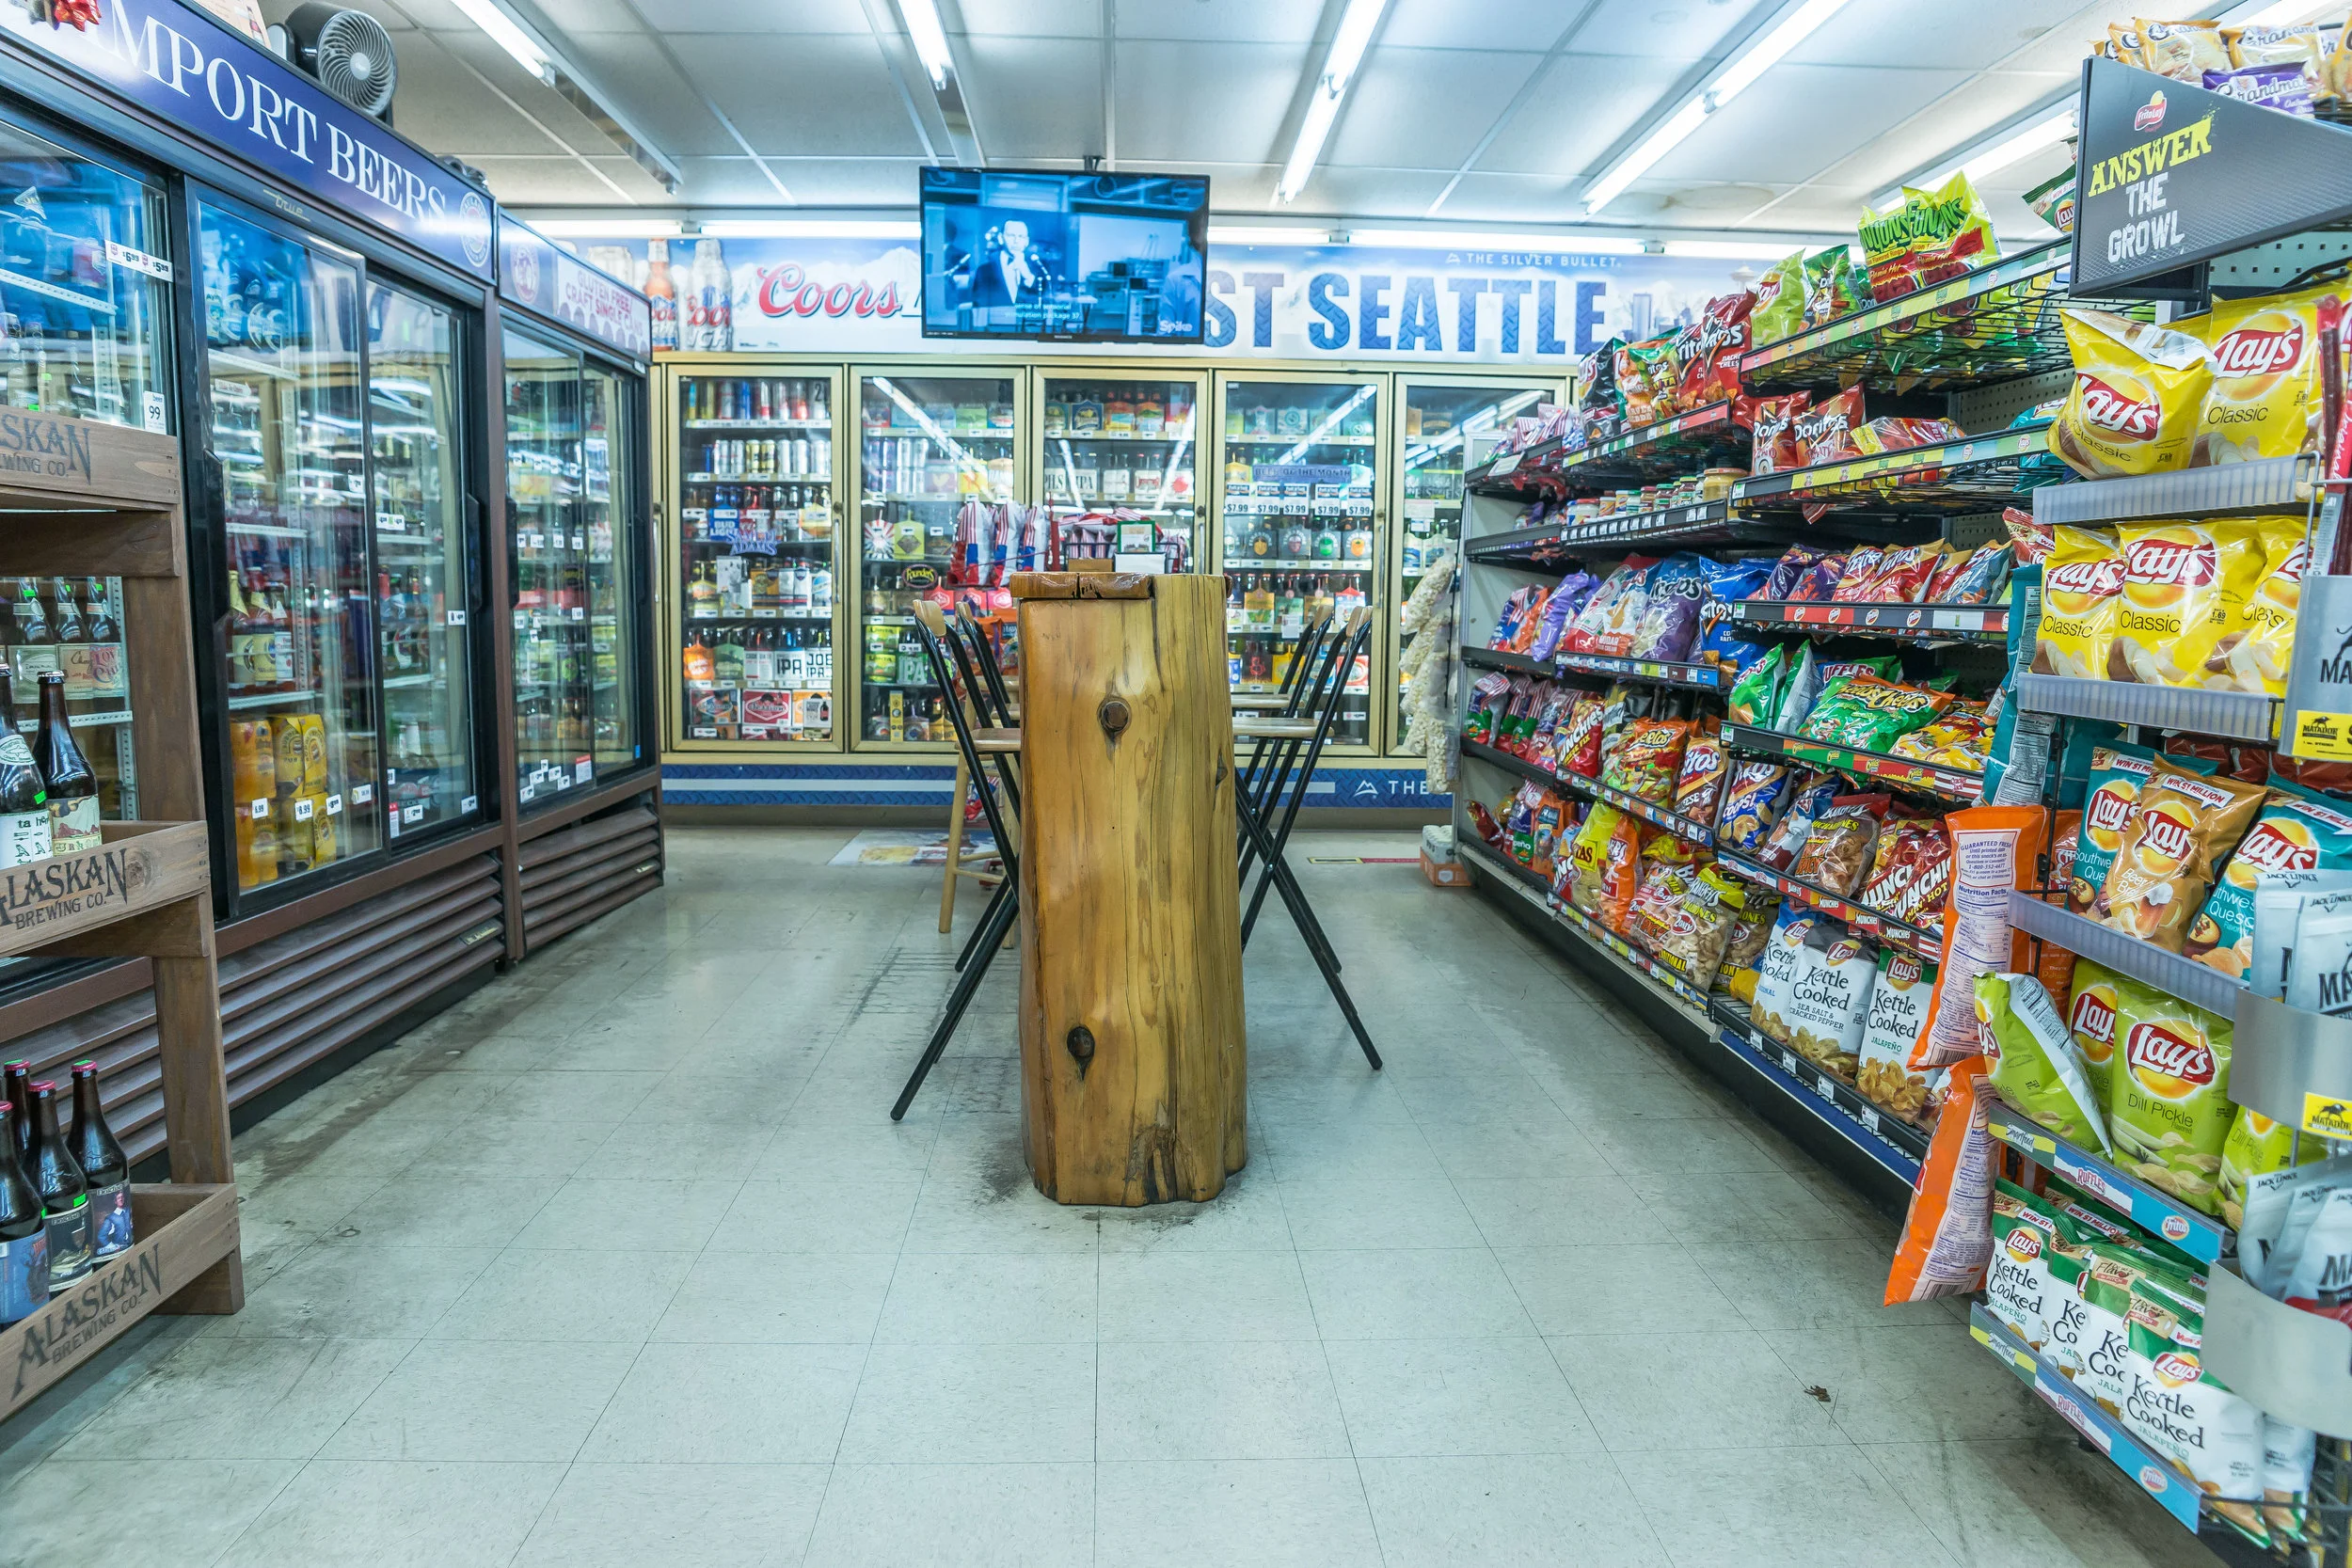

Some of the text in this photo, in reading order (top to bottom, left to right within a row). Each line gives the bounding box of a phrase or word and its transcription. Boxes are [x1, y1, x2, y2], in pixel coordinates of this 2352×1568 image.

[2088, 117, 2212, 198] ANSWER
[326, 120, 447, 225] BEERS
[2126, 172, 2169, 217] THE
[2107, 211, 2185, 263] GROWL
[1467, 253, 1617, 268] THE SILVER BULLET
[757, 262, 900, 319] Coors
[1159, 320, 1193, 333] Spike
[1309, 274, 1607, 356] SEATTLE
[2217, 328, 2302, 379] Lay's
[149, 405, 161, 420] 99
[2207, 403, 2268, 426] Classic
[2073, 419, 2131, 463] Classic
[1318, 468, 1351, 478] MONTH
[1227, 504, 1248, 513] $7.99
[1258, 505, 1279, 514] $7.99
[1285, 505, 1306, 514] $7.99
[1318, 506, 1339, 515] $7.99
[1349, 506, 1370, 515] $7.99
[714, 520, 736, 529] BUD
[729, 542, 778, 556] ADAMS
[2125, 540, 2213, 585] Lay's
[2042, 614, 2093, 639] Classic
[2120, 610, 2182, 634] Classic
[777, 658, 803, 675] IPA
[806, 653, 833, 666] JOE
[806, 667, 824, 678] IPA
[2302, 725, 2339, 736] MATADOR
[2116, 758, 2132, 769] WIN
[1389, 780, 1427, 795] THE
[2167, 777, 2181, 788] WIN
[2190, 784, 2226, 803] MILLION
[1961, 840, 1998, 851] GUARANTEED
[1927, 882, 1947, 903] HOT
[1958, 884, 2007, 896] Nutrition Facts
[16, 892, 107, 930] BREWING CO.
[1803, 965, 1849, 990] Kettle
[1888, 960, 1919, 983] Lay's
[1793, 981, 1851, 1013] Cooked
[1797, 1002, 1810, 1013] SEA
[1812, 1006, 1828, 1017] SALT
[1874, 988, 1916, 1017] Kettle
[1789, 1007, 1845, 1031] CRACKED PEPPER
[1867, 1009, 1919, 1039] Cooked
[1870, 1035, 1903, 1053] JALAPEÑO
[2130, 1025, 2213, 1084] Lay's
[2127, 1093, 2194, 1129] Dill Pickle
[2076, 1169, 2106, 1196] RUFFLES
[2023, 1211, 2037, 1224] WIN
[2068, 1206, 2084, 1218] WIN
[2091, 1217, 2123, 1236] MILLION
[2007, 1231, 2042, 1257] Lay's
[1994, 1254, 2039, 1291] Kettle
[1989, 1273, 2043, 1315] Cooked
[11, 1243, 162, 1402] ALASKAN
[52, 1294, 141, 1365] BREWING CO.
[2160, 1354, 2203, 1382] Lay's
[2131, 1371, 2196, 1420] Kettle
[2057, 1394, 2086, 1427] RUFFLES
[2126, 1395, 2205, 1449] Cooked
